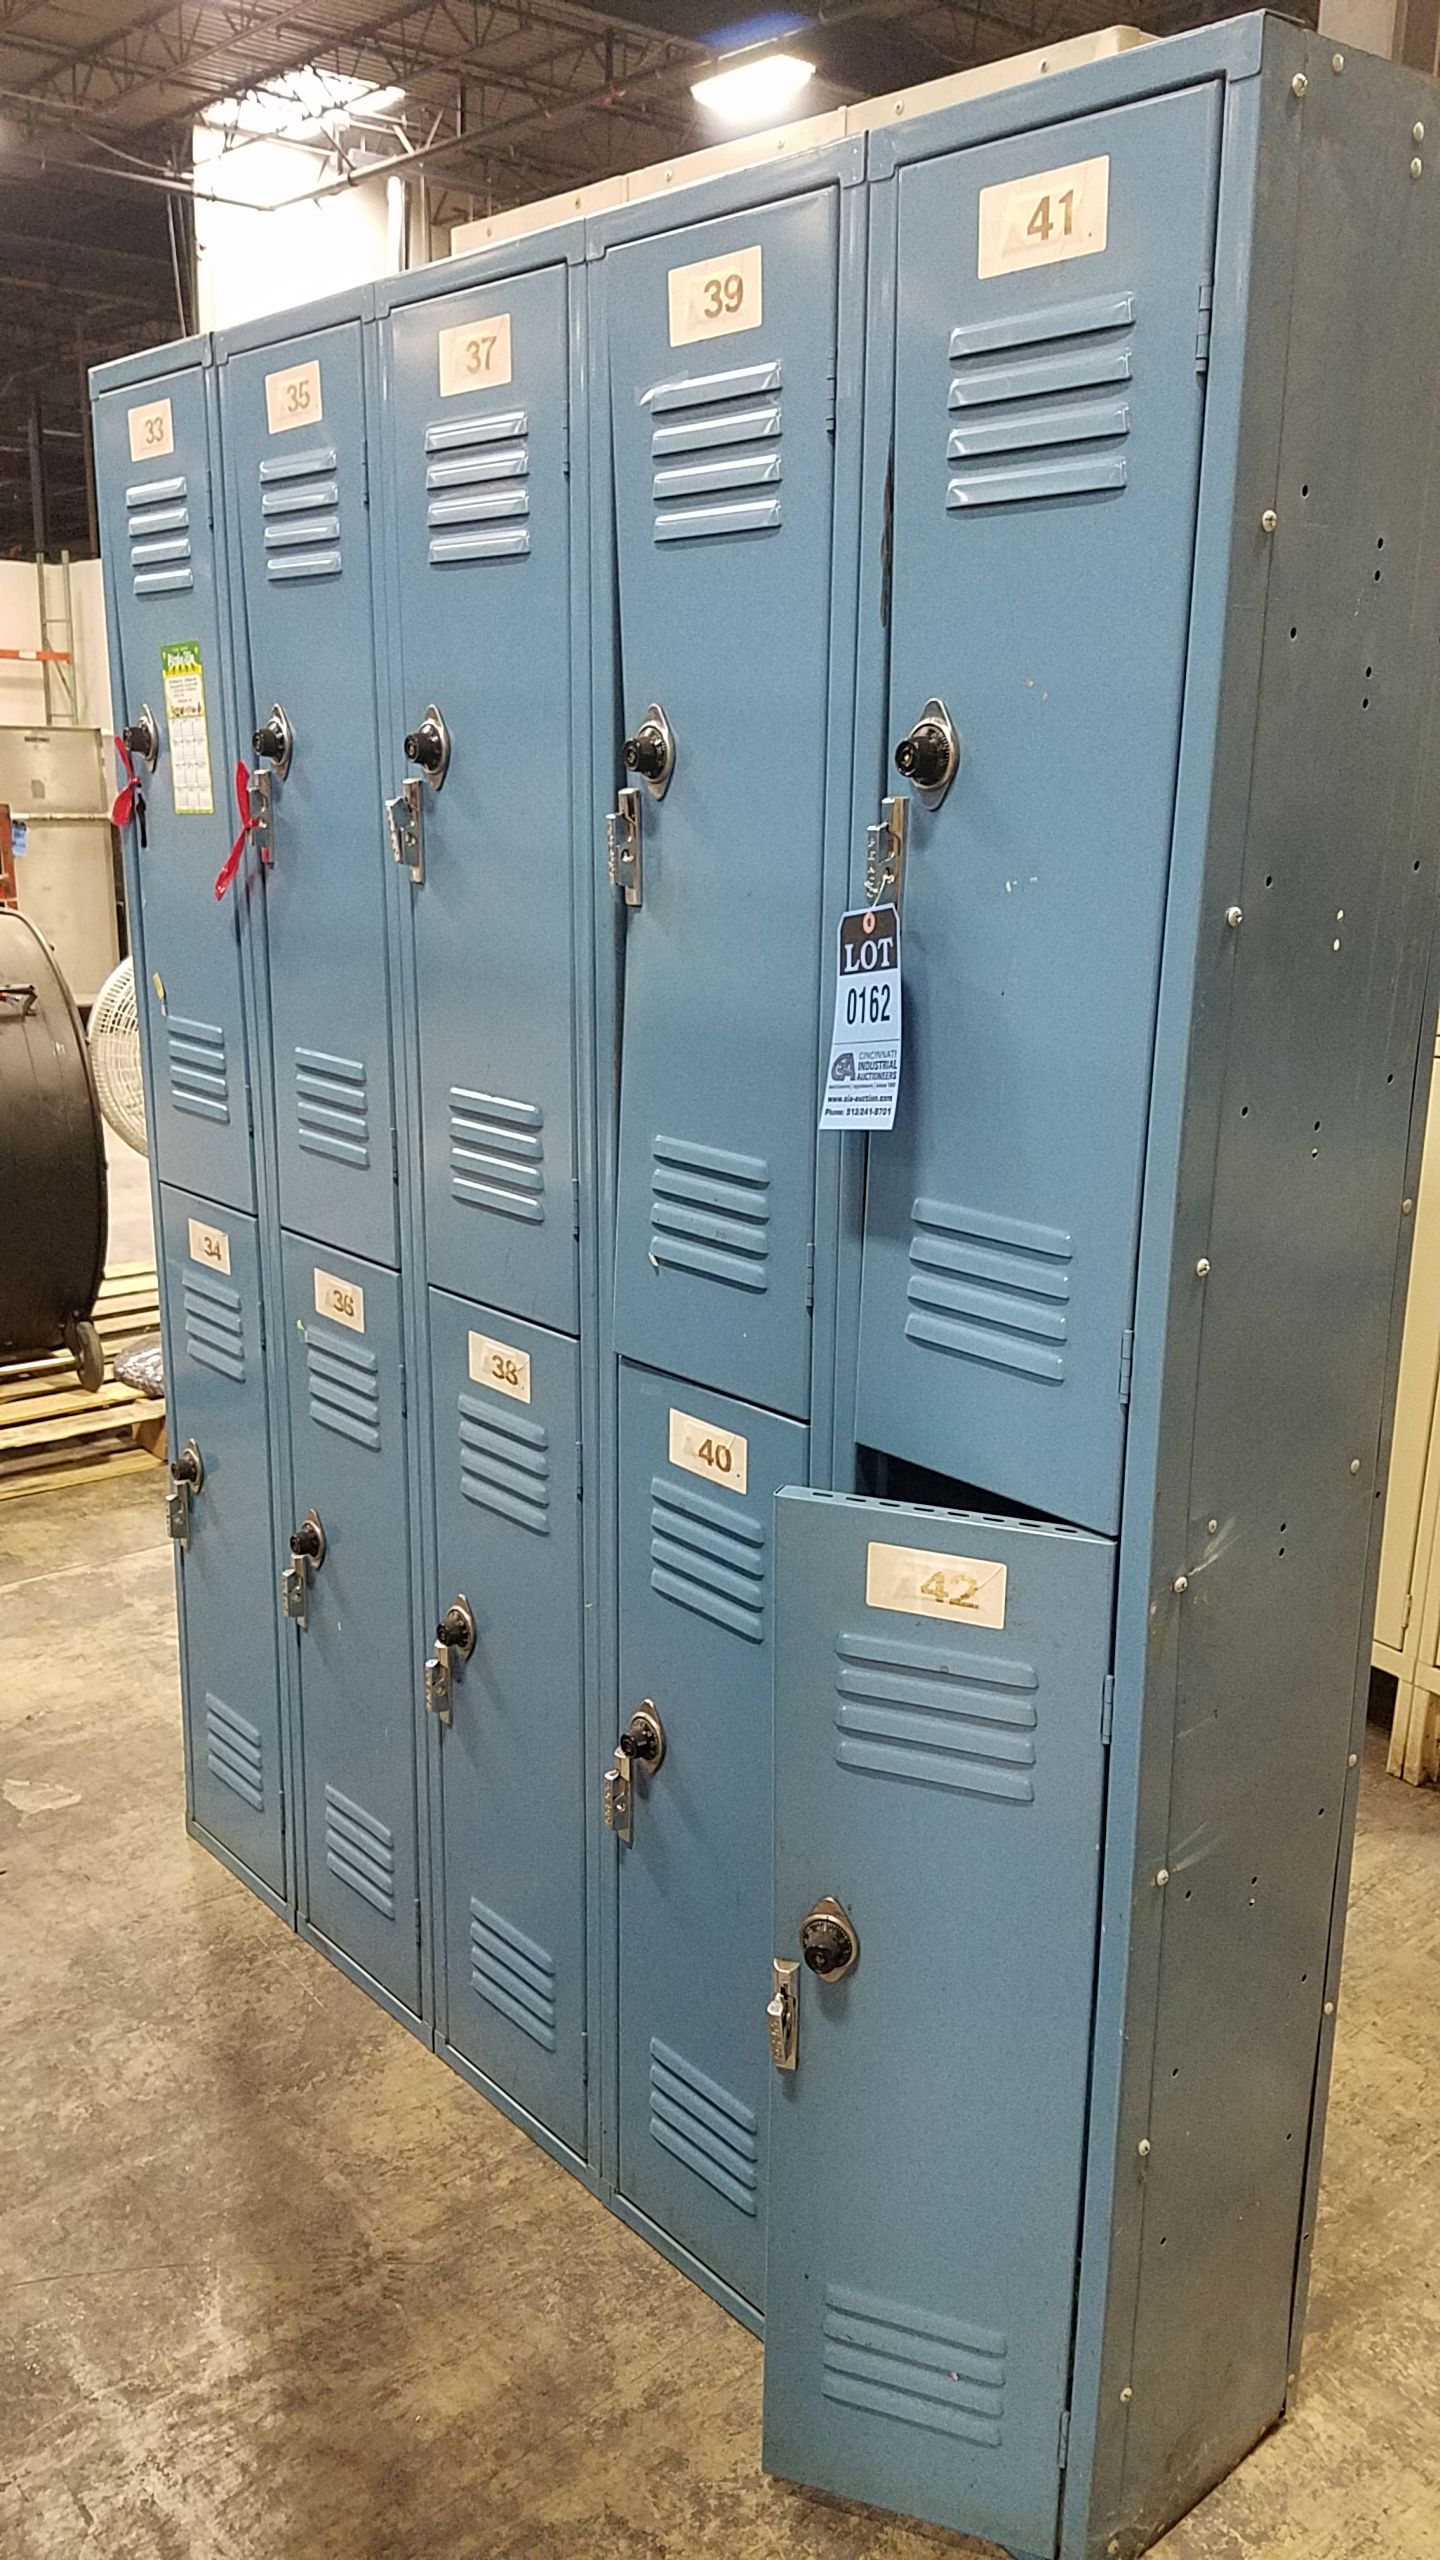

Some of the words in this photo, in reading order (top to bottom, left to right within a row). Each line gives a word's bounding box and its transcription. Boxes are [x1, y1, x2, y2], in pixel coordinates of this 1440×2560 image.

[1026, 189, 1075, 242] 41
[702, 273, 745, 320] 39
[465, 335, 498, 375] 37
[286, 379, 311, 413] 35
[144, 416, 165, 445] 33
[843, 936, 894, 973] LOT
[846, 983, 891, 1026] 0162
[857, 1059, 898, 1072] INDUSTRIAL
[859, 1049, 898, 1061] CINCINNATI
[856, 1070, 897, 1081] AUCTIONEERS
[203, 1236, 222, 1262] 34
[332, 1289, 355, 1318] 36
[491, 1353, 519, 1387] 38
[698, 1437, 732, 1474] 40
[919, 1570, 980, 1610] 42
